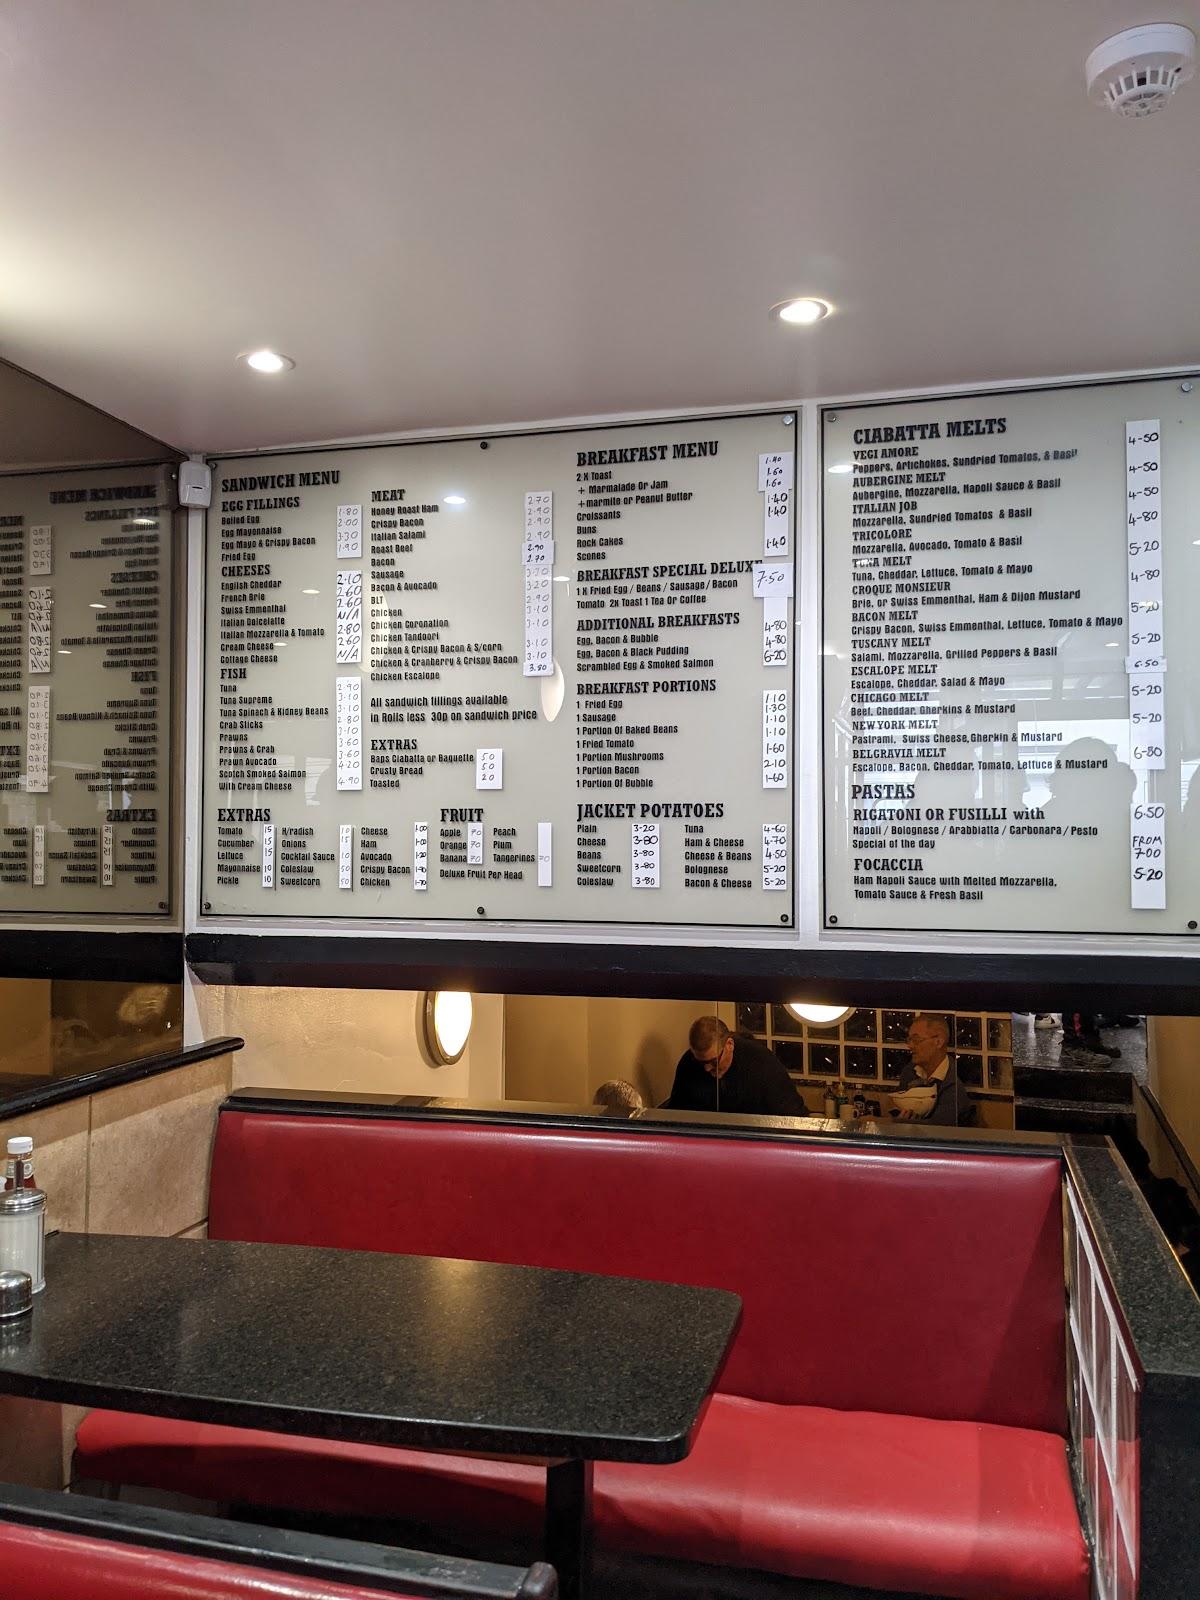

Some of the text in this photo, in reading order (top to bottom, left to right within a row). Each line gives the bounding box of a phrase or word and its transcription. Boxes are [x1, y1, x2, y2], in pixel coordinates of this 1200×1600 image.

[854, 418, 1007, 444] CIABATTA MELTS
[577, 441, 719, 466] BREAKFAST MENU
[853, 447, 918, 461] VEGI AMORE
[222, 471, 340, 492] SANDWICH MENU
[853, 472, 945, 488] AUBERGINE MELT
[372, 489, 405, 502] MEAT
[222, 497, 300, 512] EGG FILLINGS
[853, 501, 918, 514] ITALIAN JOB
[371, 504, 438, 516] Honey Roast Ham
[222, 516, 260, 525] Boiled Egg
[577, 511, 621, 522] Croissants
[222, 527, 281, 537] Egg Mayonnaise
[577, 525, 597, 535] Buns
[853, 528, 912, 541] TRICOLORE
[222, 541, 234, 550] Egg
[237, 540, 256, 549] Mayo
[265, 539, 290, 547] Crispy
[293, 537, 316, 545] Bacon
[577, 537, 623, 548] Rock Cakes
[577, 552, 606, 561] Scones
[883, 556, 912, 566] MELT
[371, 558, 395, 567] Bacon
[222, 564, 270, 577] CHEESES
[371, 571, 404, 579] Sausage
[577, 567, 649, 582] BREAKFAST
[653, 563, 707, 578] SPECIAL
[221, 581, 282, 590] English Cheddar
[852, 582, 950, 596] CROQUE MONSIEUR
[221, 594, 246, 602] French
[371, 596, 383, 604] BLT
[371, 608, 402, 617] Chicken
[852, 611, 918, 622] BACON MELT
[577, 613, 740, 631] ADDITIONAL BREAKFASTS
[220, 642, 274, 652] Cream Cheese
[852, 637, 931, 649] TUSCANY MELT
[577, 662, 620, 672] Scrambled
[623, 662, 637, 671] Egg
[648, 660, 679, 669] Smoked
[683, 659, 714, 668] Salmon
[852, 665, 937, 676] ESCALOPE MELT
[220, 668, 247, 679] FISH
[220, 685, 237, 693] Tuna
[577, 680, 716, 695] BREAKFAST PORTIONS
[371, 695, 508, 707] All sandwich fillings available
[851, 692, 929, 702] CHICAGO MELT
[371, 710, 537, 722] in Rolls less 30p on sandwich price
[582, 713, 616, 722] Sausage
[909, 720, 938, 729] MELT
[582, 727, 612, 735] Portion
[625, 725, 650, 734] Baked
[653, 725, 678, 734] Beans
[371, 739, 417, 751] EXTRAS
[853, 748, 946, 759] BELGRAVIA MELT
[370, 779, 400, 788] Toasted
[852, 785, 915, 799] PASTAS
[217, 809, 271, 821] EXTRAS
[440, 809, 484, 822] FRUIT
[577, 803, 724, 822] JACKET POTATOES
[854, 807, 1045, 821] RIGATONI OR FUSILLI with
[218, 827, 242, 835] Tomato
[440, 828, 461, 837] Apple
[493, 828, 516, 836] Peach
[577, 825, 597, 833] Plain
[685, 825, 704, 834] Tuna
[218, 839, 254, 848] Cucumber
[282, 839, 306, 848] Onions
[361, 840, 377, 848] Ham
[493, 841, 512, 849] Plum
[577, 838, 606, 846] Cheese
[685, 838, 703, 847] Ham
[713, 838, 744, 847] Cheese
[853, 839, 935, 849] Special of the day
[577, 851, 601, 860] Beans
[577, 864, 621, 873] Sweetcorn
[685, 865, 728, 874] Bolognese
[854, 859, 923, 871] FOCACCIA
[440, 869, 523, 879] Deluxe Fruit Per Head
[577, 877, 614, 886] Coleslaw
[855, 890, 886, 899] Tomato
[890, 890, 917, 899] Sauce
[929, 890, 956, 900] Fresh
[960, 890, 983, 900] Basil
